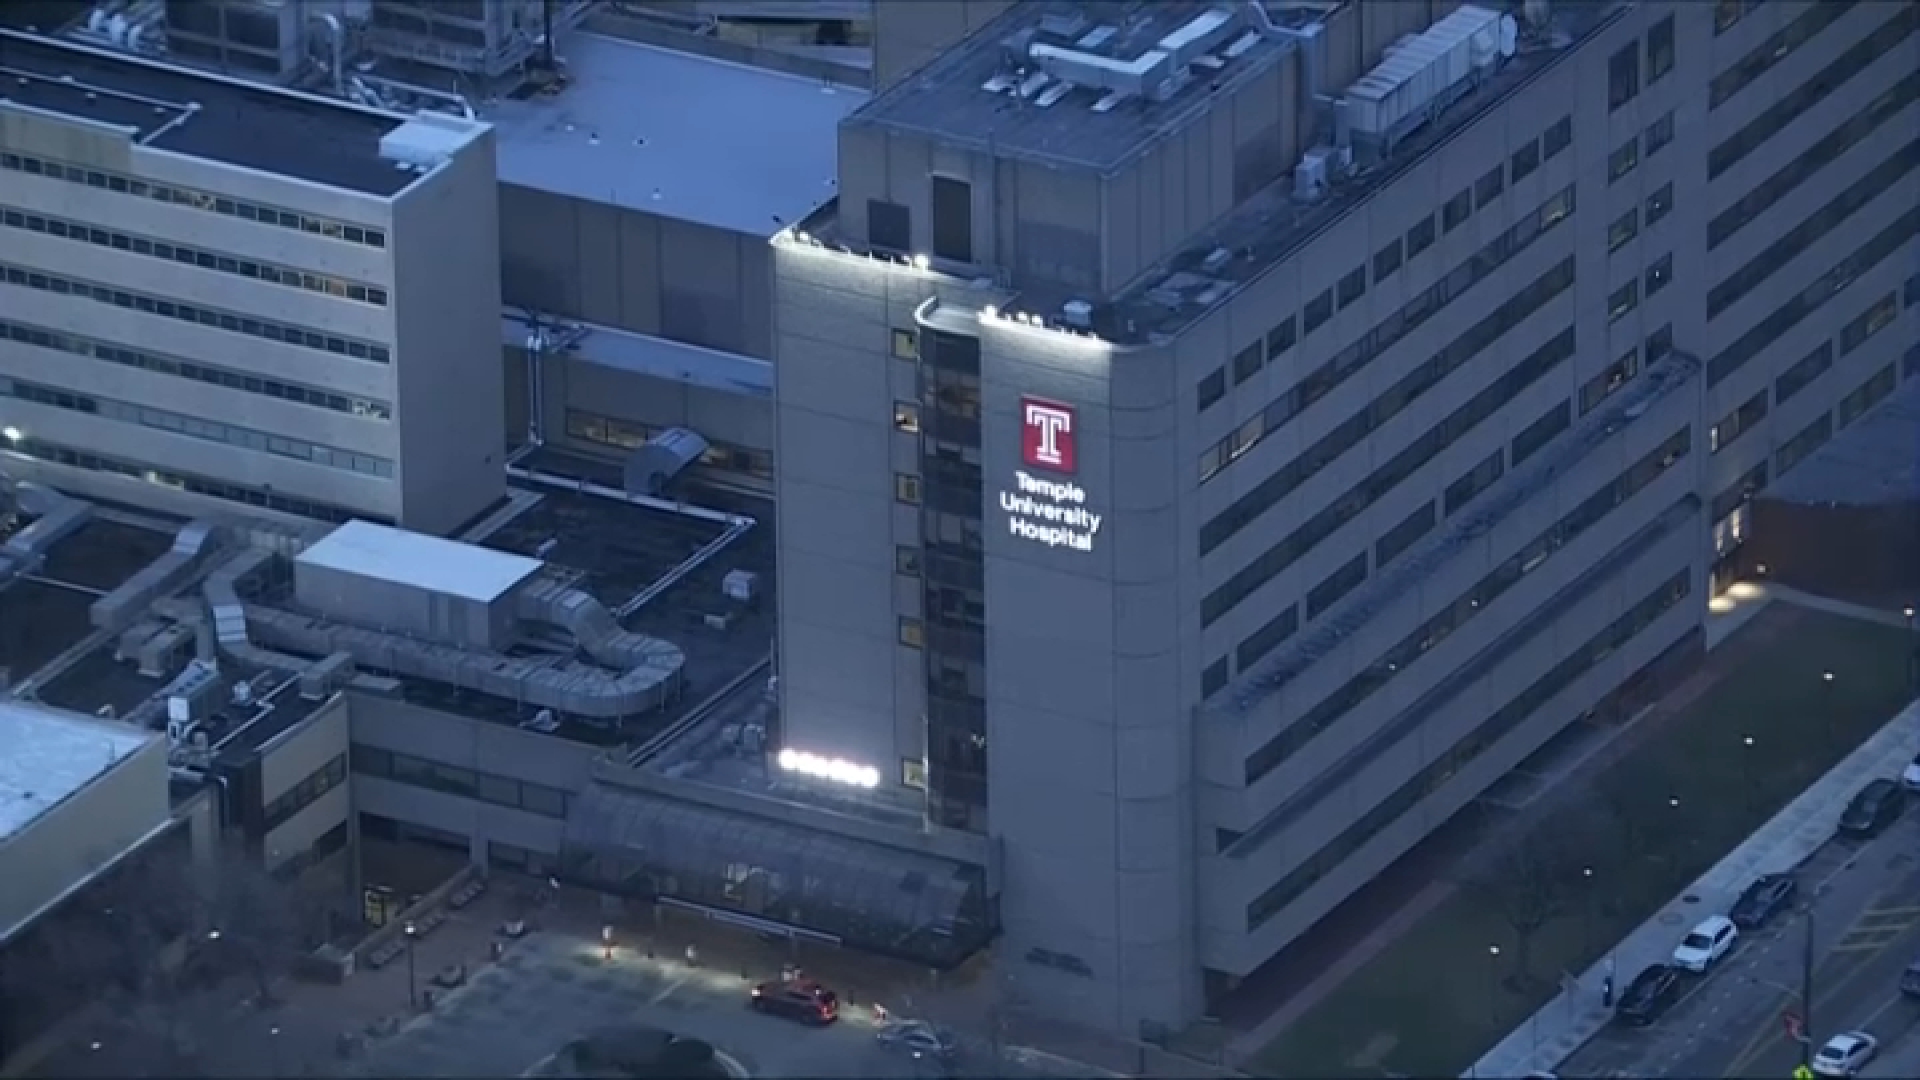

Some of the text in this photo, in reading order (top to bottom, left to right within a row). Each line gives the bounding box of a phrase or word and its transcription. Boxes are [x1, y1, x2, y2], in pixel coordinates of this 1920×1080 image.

[1015, 470, 1085, 503] Temple
[1000, 490, 1101, 533] University
[1010, 516, 1091, 552] Hospital
